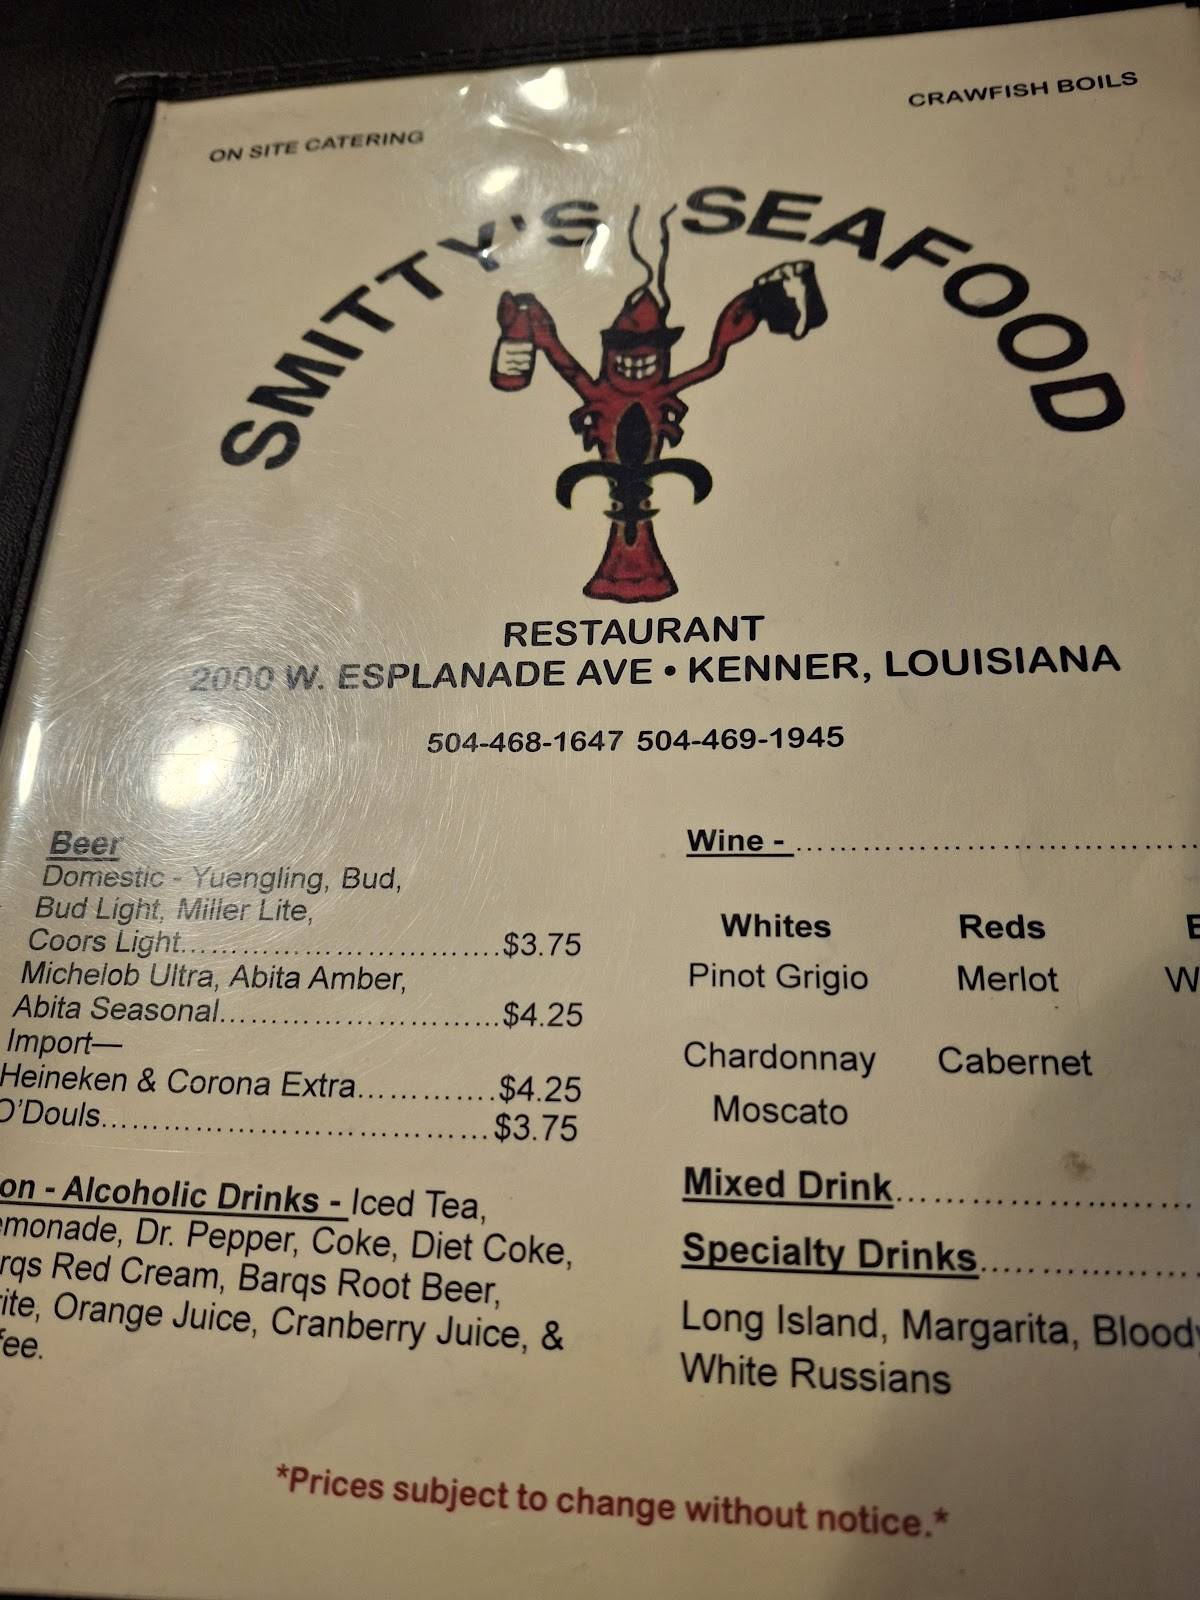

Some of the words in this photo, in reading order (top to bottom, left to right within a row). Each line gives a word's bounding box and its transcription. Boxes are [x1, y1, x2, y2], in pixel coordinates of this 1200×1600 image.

[907, 80, 1049, 108] CRAWFISH
[1056, 71, 1139, 94] BOILS
[208, 147, 244, 163] ON
[248, 140, 299, 159] SITE
[304, 130, 424, 152] CATERING
[219, 200, 601, 470] SMITTY'S
[680, 185, 1126, 432] SEAFOOD
[503, 614, 766, 648] RESTAURANT
[190, 664, 275, 691] 2000
[286, 664, 324, 690] W.
[337, 660, 566, 690] ESPLANADE
[576, 657, 653, 687] AVE
[688, 652, 871, 684] KENNER,
[885, 643, 1122, 678] LOUISIANA
[426, 729, 624, 754] 504-468-1647
[636, 725, 845, 752] 504-469-1945
[48, 830, 121, 862] Beer
[685, 828, 765, 857] Wine
[42, 864, 166, 889] Domestic
[192, 865, 331, 897] Yuengling,
[341, 866, 401, 894] Bud,
[35, 895, 88, 920] Bud
[96, 896, 166, 925] Light,
[176, 896, 251, 924] Miller
[258, 898, 313, 926] Lite,
[719, 912, 832, 939] Whites
[959, 913, 1046, 940] Reds
[28, 927, 107, 955] Coors
[114, 928, 181, 958] Light
[502, 931, 582, 960] $3.75
[20, 955, 145, 987] Michelob
[150, 962, 219, 993] Ultra,
[228, 963, 301, 990] Abita
[306, 965, 406, 996] Amber,
[689, 961, 767, 989] Pinot
[775, 962, 869, 997] Grigio
[957, 964, 1060, 993] Merlot
[11, 993, 82, 1020] Abita
[90, 995, 220, 1023] Seasonal
[502, 1000, 583, 1030] $4.25
[683, 1040, 877, 1080] Chardonnay
[937, 1045, 1094, 1077] Cabernet
[0, 1062, 128, 1093] Heineken
[136, 1066, 157, 1094] &
[167, 1067, 271, 1097] Corona
[280, 1070, 356, 1099] Extra
[498, 1073, 582, 1105] $4.25
[493, 1111, 578, 1144] $3.75
[713, 1093, 849, 1127] Moscato
[62, 1175, 209, 1212] Alcoholic
[216, 1181, 321, 1218] Drinks
[351, 1186, 416, 1218] Iced
[424, 1189, 486, 1226] Tea,
[683, 1165, 786, 1205] Mixed
[798, 1169, 893, 1209] Drink
[0, 1214, 122, 1249] monade,
[135, 1216, 174, 1247] Dr.
[186, 1217, 303, 1259] Pepper,
[312, 1225, 398, 1263] Coke,
[411, 1229, 474, 1262] Diet
[483, 1232, 572, 1271] Coke,
[681, 1231, 846, 1274] Specialty
[856, 1237, 979, 1279] Drinks
[51, 1251, 112, 1283] Red
[120, 1253, 231, 1295] Cream,
[238, 1262, 327, 1299] Barqs
[337, 1267, 412, 1301] Root
[421, 1271, 500, 1311] Beer,
[53, 1291, 163, 1333] Orange
[171, 1299, 257, 1339] Juice,
[271, 1305, 427, 1351] Cranberry
[435, 1314, 528, 1355] Juice,
[540, 1319, 565, 1351] &
[682, 1299, 764, 1342] Long
[777, 1303, 888, 1345] Island,
[902, 1308, 1079, 1351] Margarita,
[679, 1351, 779, 1388] White
[790, 1356, 952, 1396] Russians
[392, 1475, 509, 1513] subject
[516, 1482, 549, 1512] to
[556, 1486, 677, 1527] change
[684, 1495, 809, 1530] without
